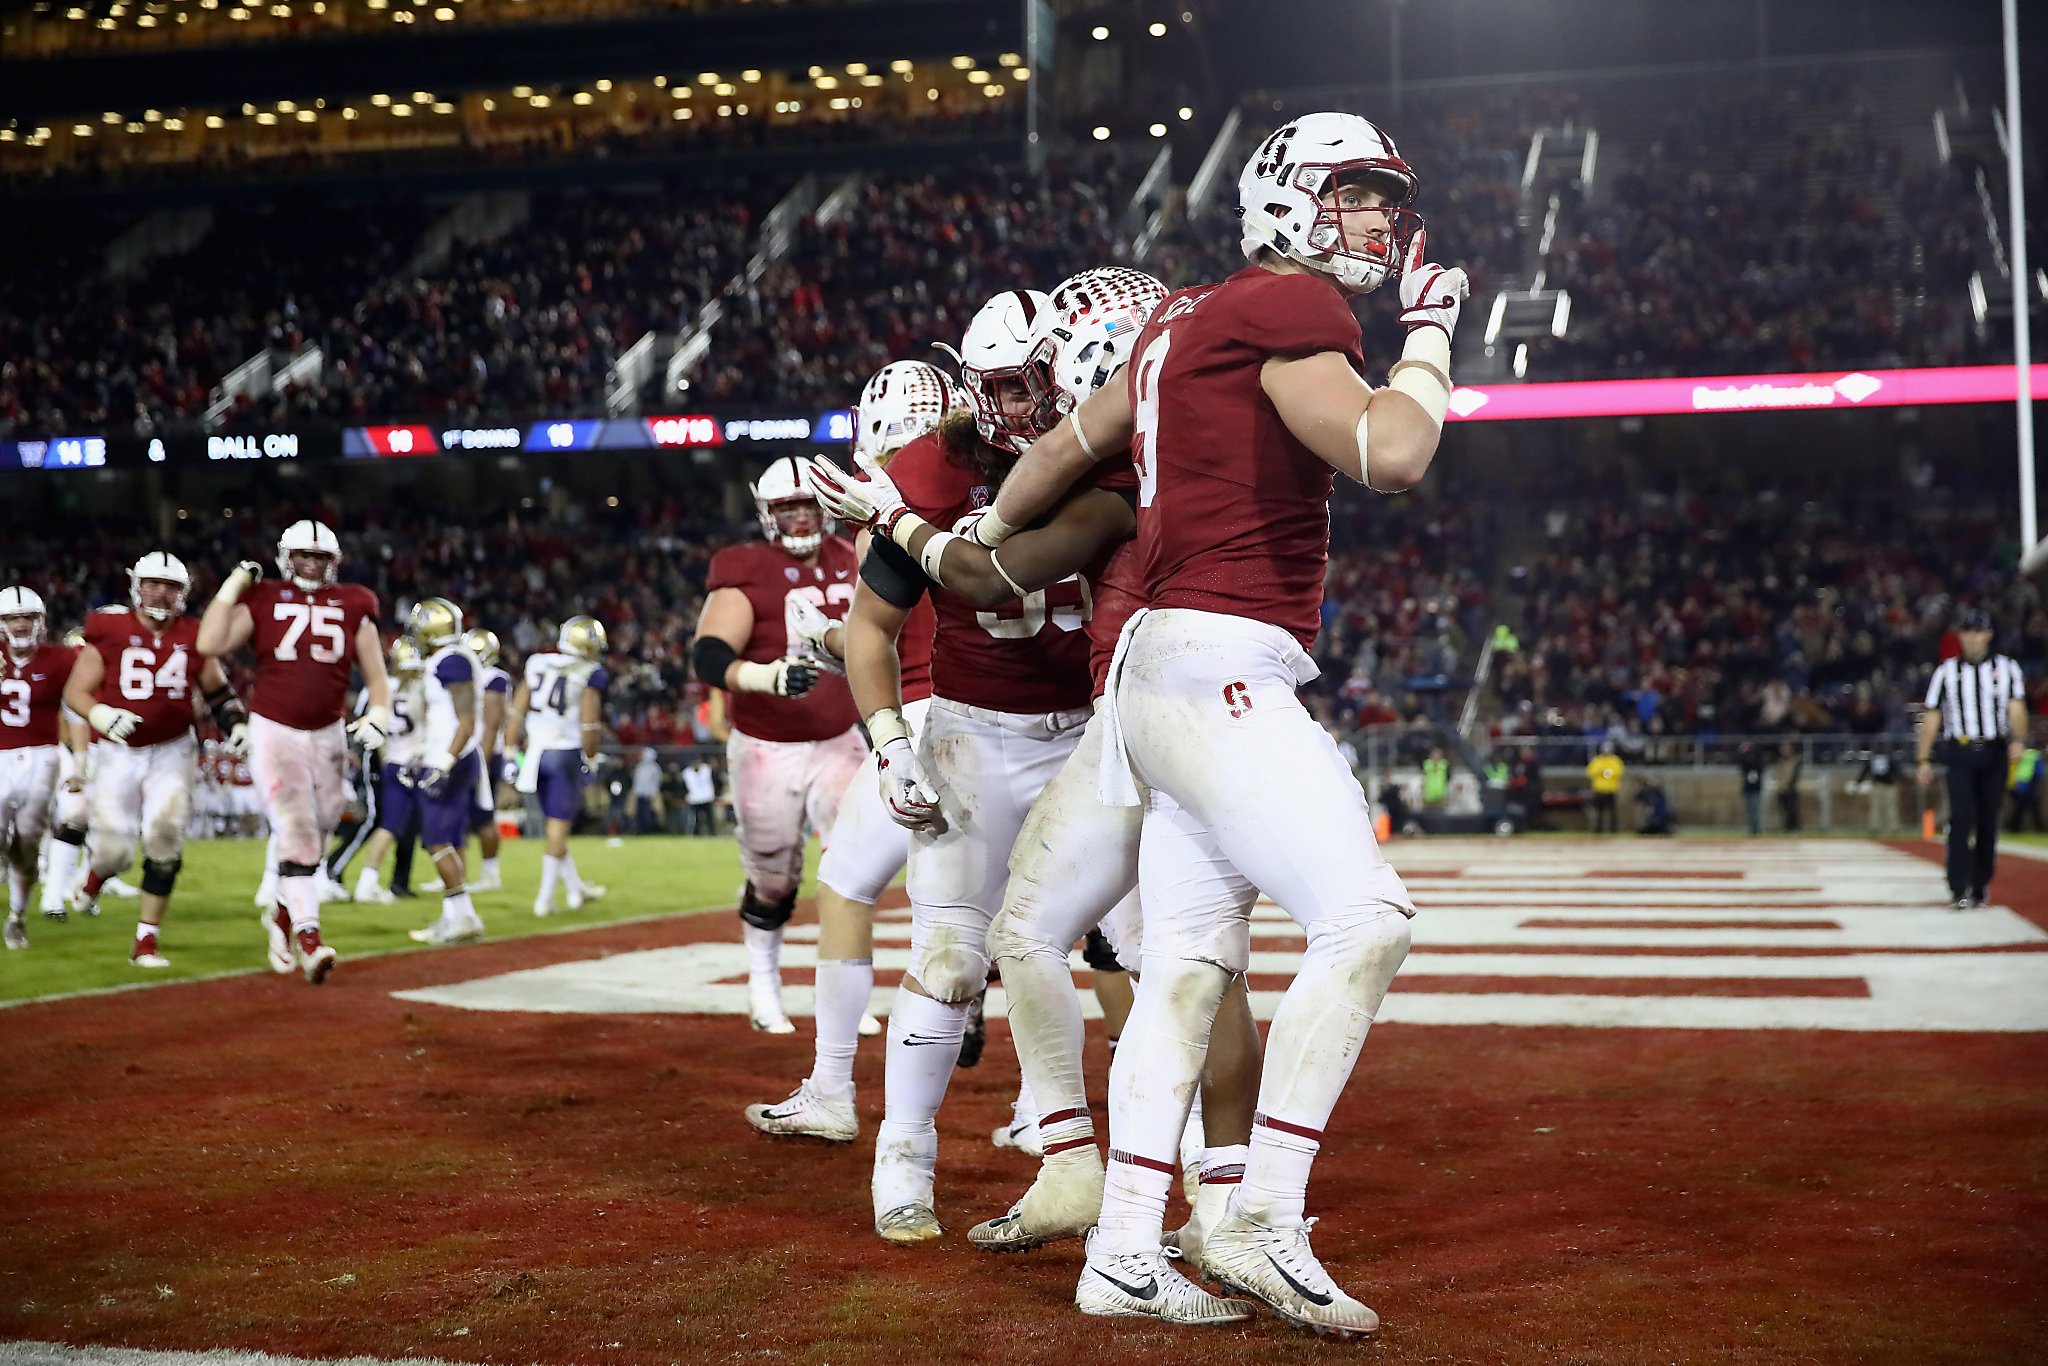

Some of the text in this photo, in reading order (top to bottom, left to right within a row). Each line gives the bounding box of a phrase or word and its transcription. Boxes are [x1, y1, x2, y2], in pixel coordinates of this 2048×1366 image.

[207, 433, 299, 460] BALL ON
[273, 602, 346, 664] 75
[119, 646, 189, 700] 64
